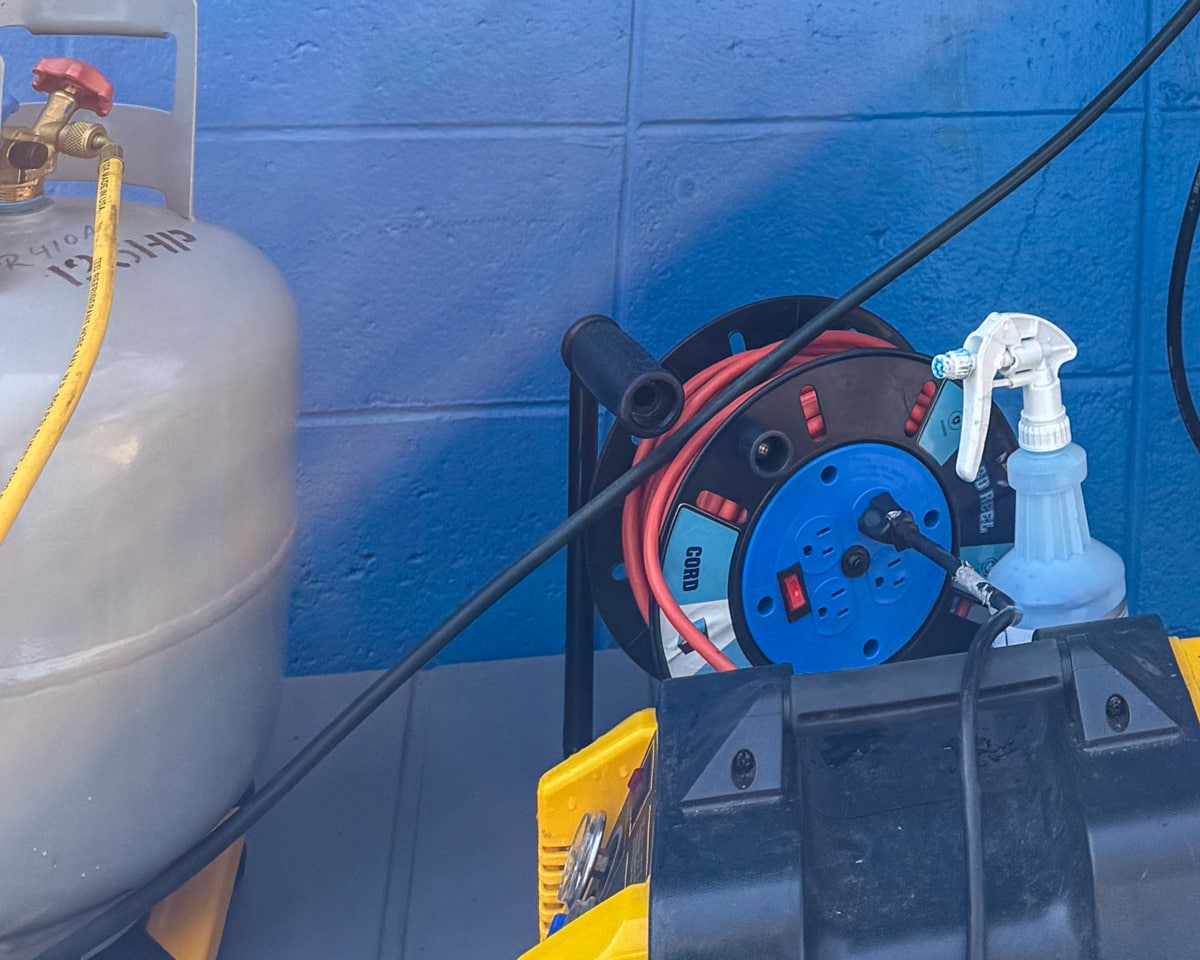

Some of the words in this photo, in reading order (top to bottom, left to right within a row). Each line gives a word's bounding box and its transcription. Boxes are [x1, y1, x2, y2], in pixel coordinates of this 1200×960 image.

[100, 172, 109, 189] MADE
[84, 272, 100, 324] REFRIGERANT
[978, 490, 995, 534] REEL
[682, 546, 703, 592] CORD
